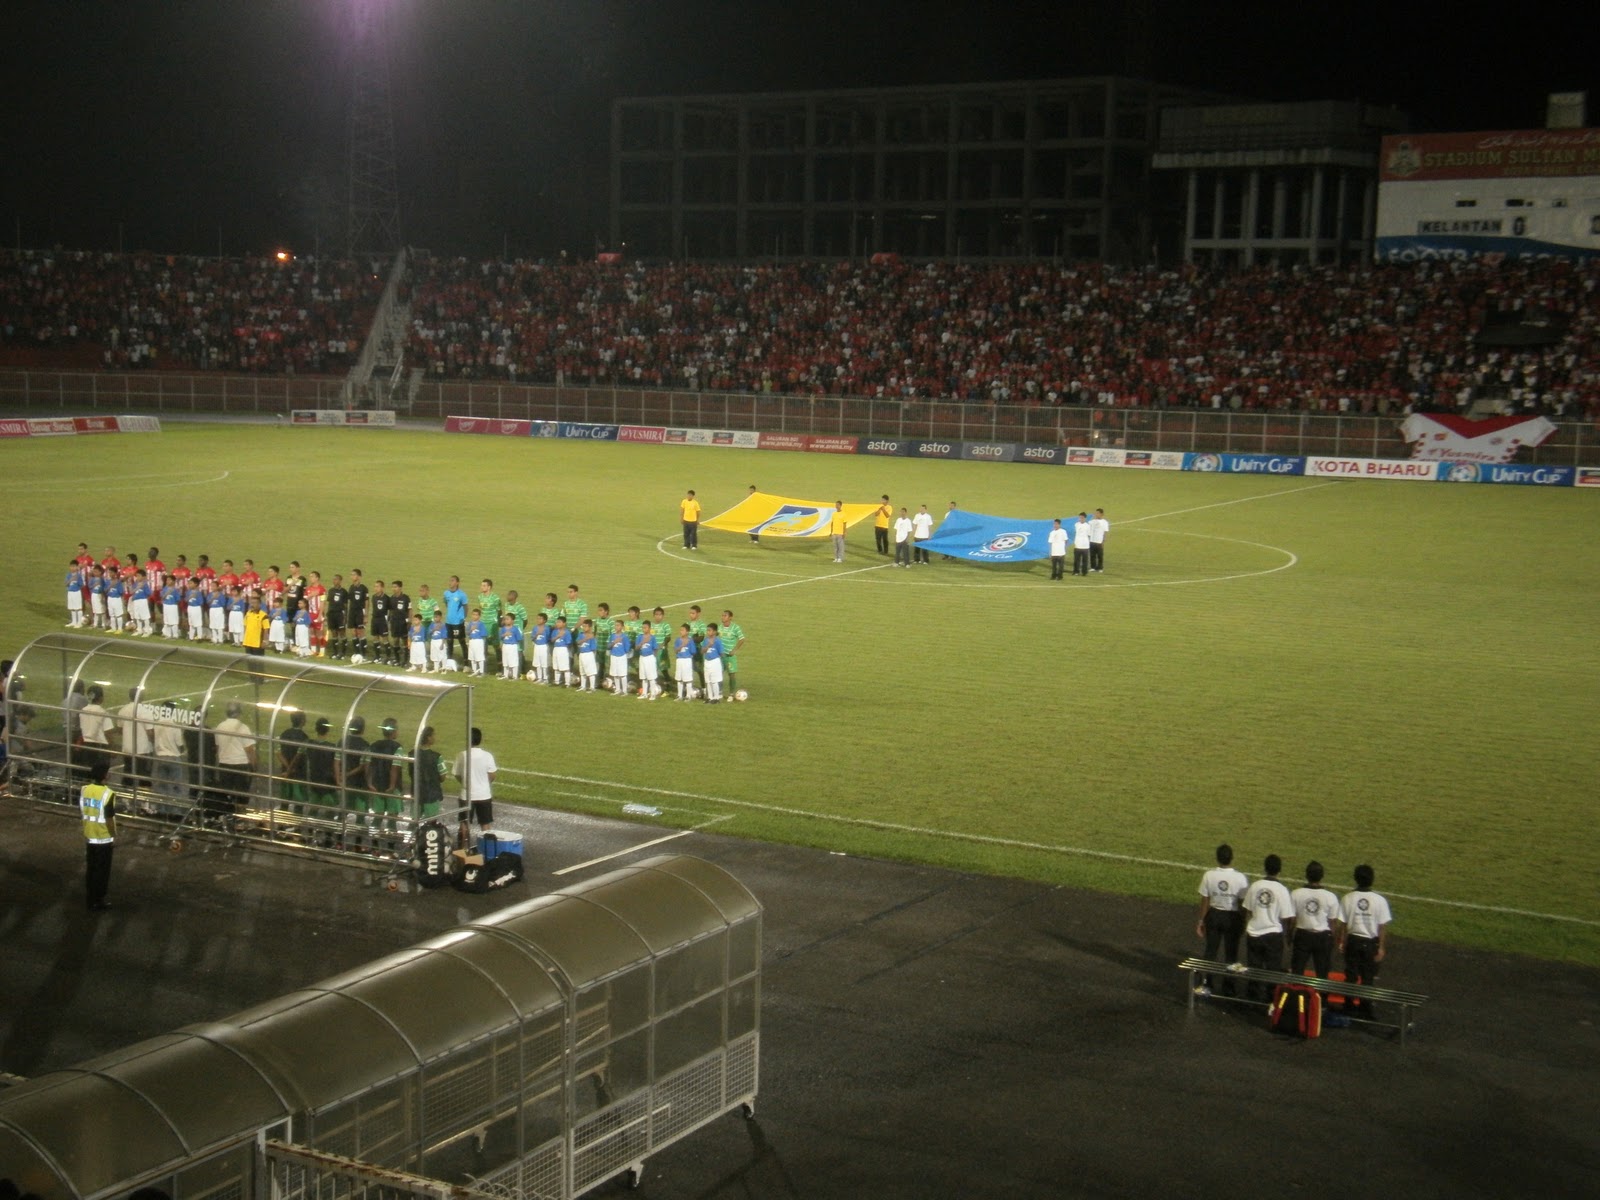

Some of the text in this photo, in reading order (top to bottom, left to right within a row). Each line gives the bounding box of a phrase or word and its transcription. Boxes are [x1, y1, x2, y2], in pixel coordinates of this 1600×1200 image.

[1424, 151, 1502, 167] STADIUM
[1508, 148, 1576, 163] SULTAN
[1422, 220, 1502, 233] KELANTAN
[628, 429, 663, 441] YUSMIRA
[867, 440, 897, 451] astro
[919, 442, 950, 453] astro
[972, 444, 1002, 456] astro
[1024, 446, 1055, 458] astro
[1314, 460, 1360, 473] KOTA
[1366, 462, 1430, 476] BHARU
[424, 829, 439, 875] mitre
